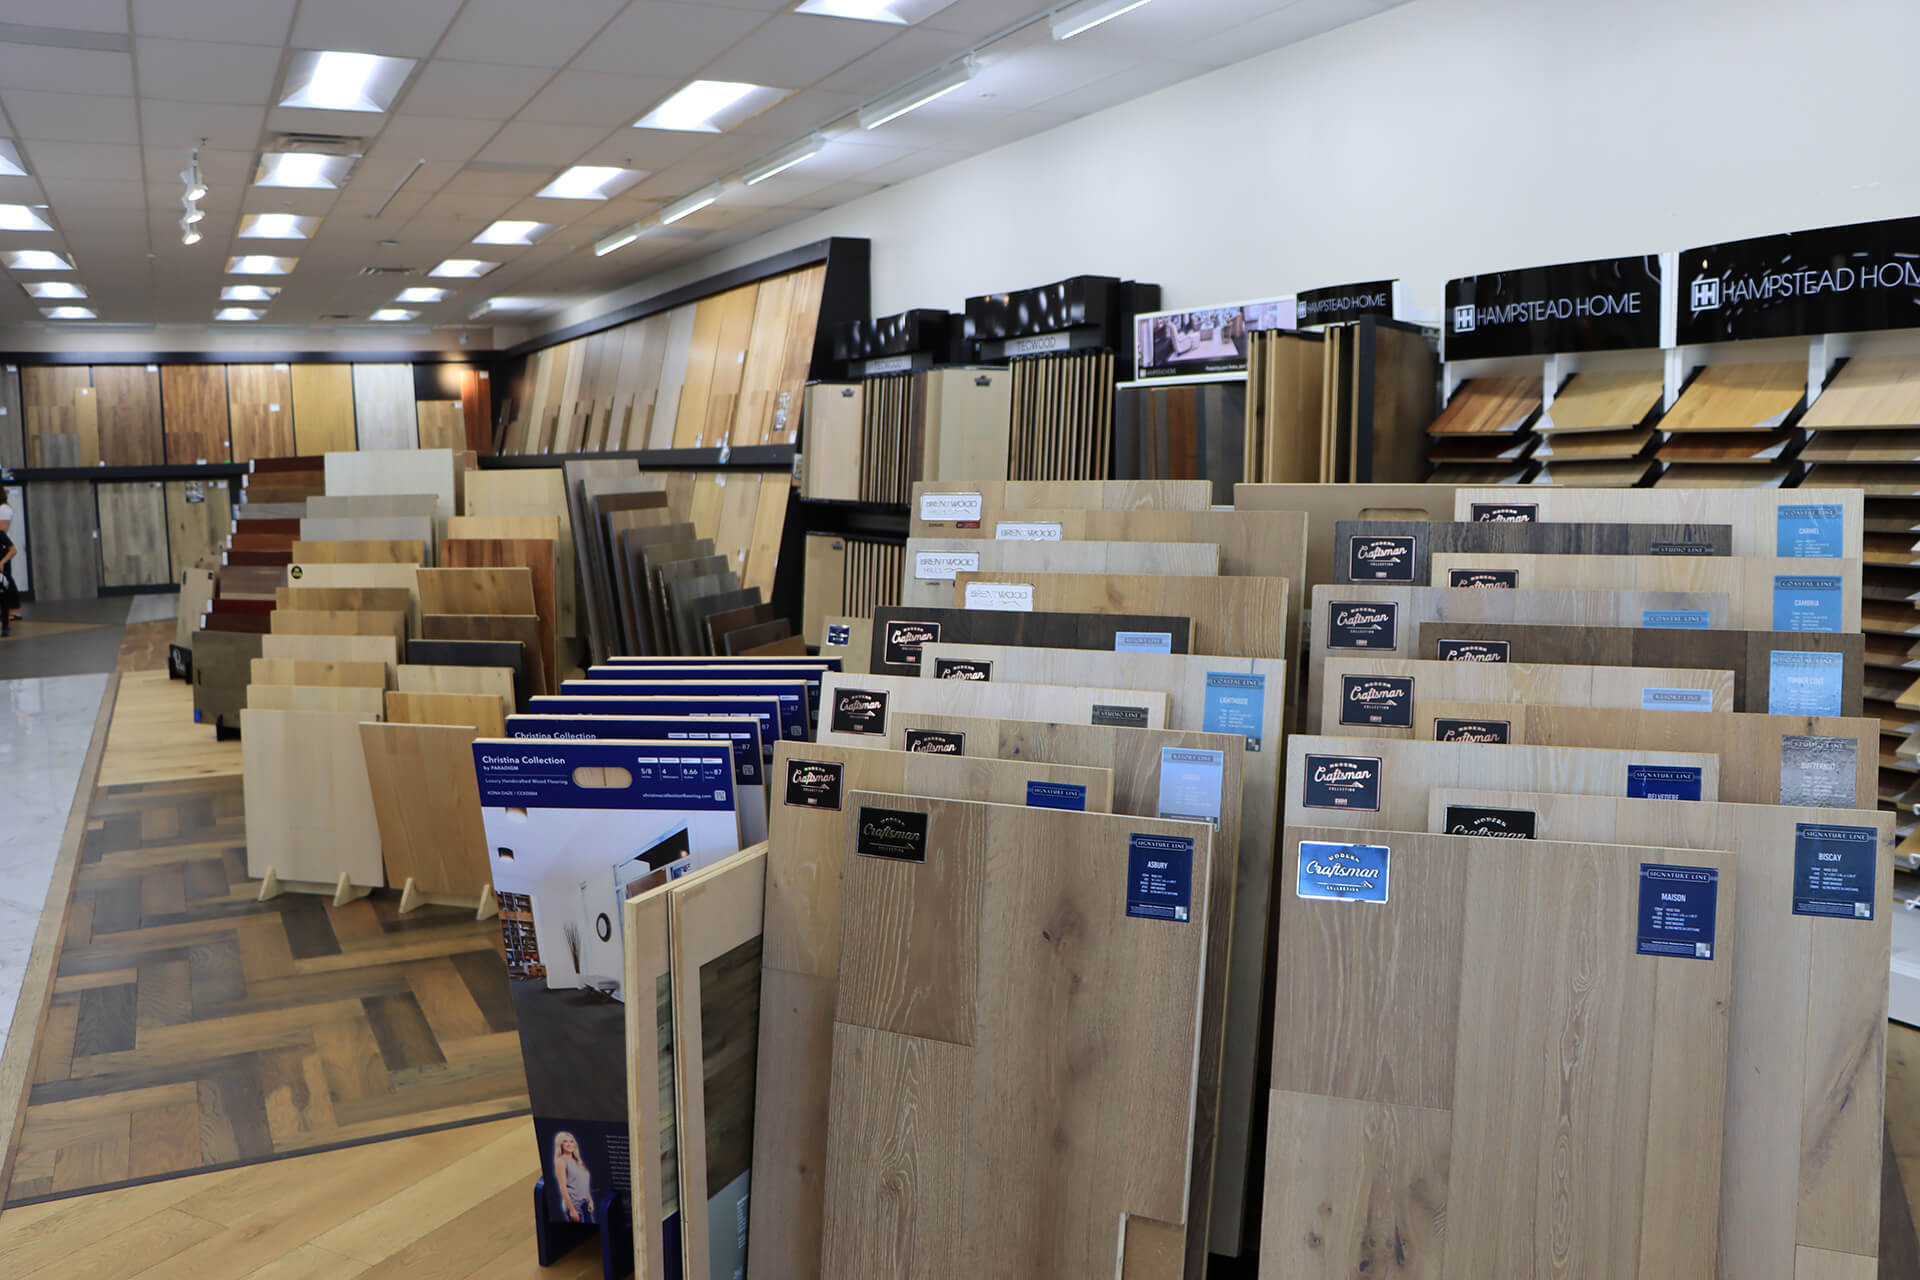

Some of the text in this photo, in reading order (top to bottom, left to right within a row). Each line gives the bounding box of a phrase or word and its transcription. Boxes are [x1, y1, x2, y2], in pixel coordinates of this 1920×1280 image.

[1722, 268, 1856, 305] HAMPSTEAD
[1307, 292, 1387, 314] HAMPSTEAD HOME
[1477, 298, 1573, 327] HAMPSTEAD
[1576, 291, 1641, 318] HOME
[1479, 513, 1530, 522] Cftsman
[1000, 529, 1057, 537] BRENTWOOD
[1357, 545, 1408, 561] Craftsman
[920, 558, 974, 566] BRENTWOOD
[1457, 579, 1509, 588] Cftsman
[1336, 612, 1389, 627] Craftsman
[1684, 615, 1700, 623] LINE
[892, 630, 934, 645] Craftsman
[1446, 650, 1501, 662] Craftsman
[942, 668, 985, 681] Craftsman
[1350, 685, 1404, 702] Craftsman
[840, 698, 882, 712] Craftsman
[514, 732, 597, 740] Christina Collection
[1443, 730, 1500, 743] Craftsman
[912, 740, 957, 754] Craftsman
[482, 755, 566, 765] Christina Collection
[792, 768, 837, 785] Craftsman
[1314, 766, 1372, 783] Craftsman
[1474, 817, 1507, 827] MODERN
[863, 822, 921, 842] Craftsman
[1452, 824, 1528, 839] Craftsman
[1806, 831, 1846, 839] SIGNATURE
[1328, 852, 1361, 863] MODERN
[1818, 852, 1842, 862] BISCAY
[1147, 860, 1169, 870] ASBURY
[1306, 860, 1380, 880] Craftsman
[1649, 871, 1689, 879] SIGNATURE
[1661, 892, 1687, 902] MAISON
